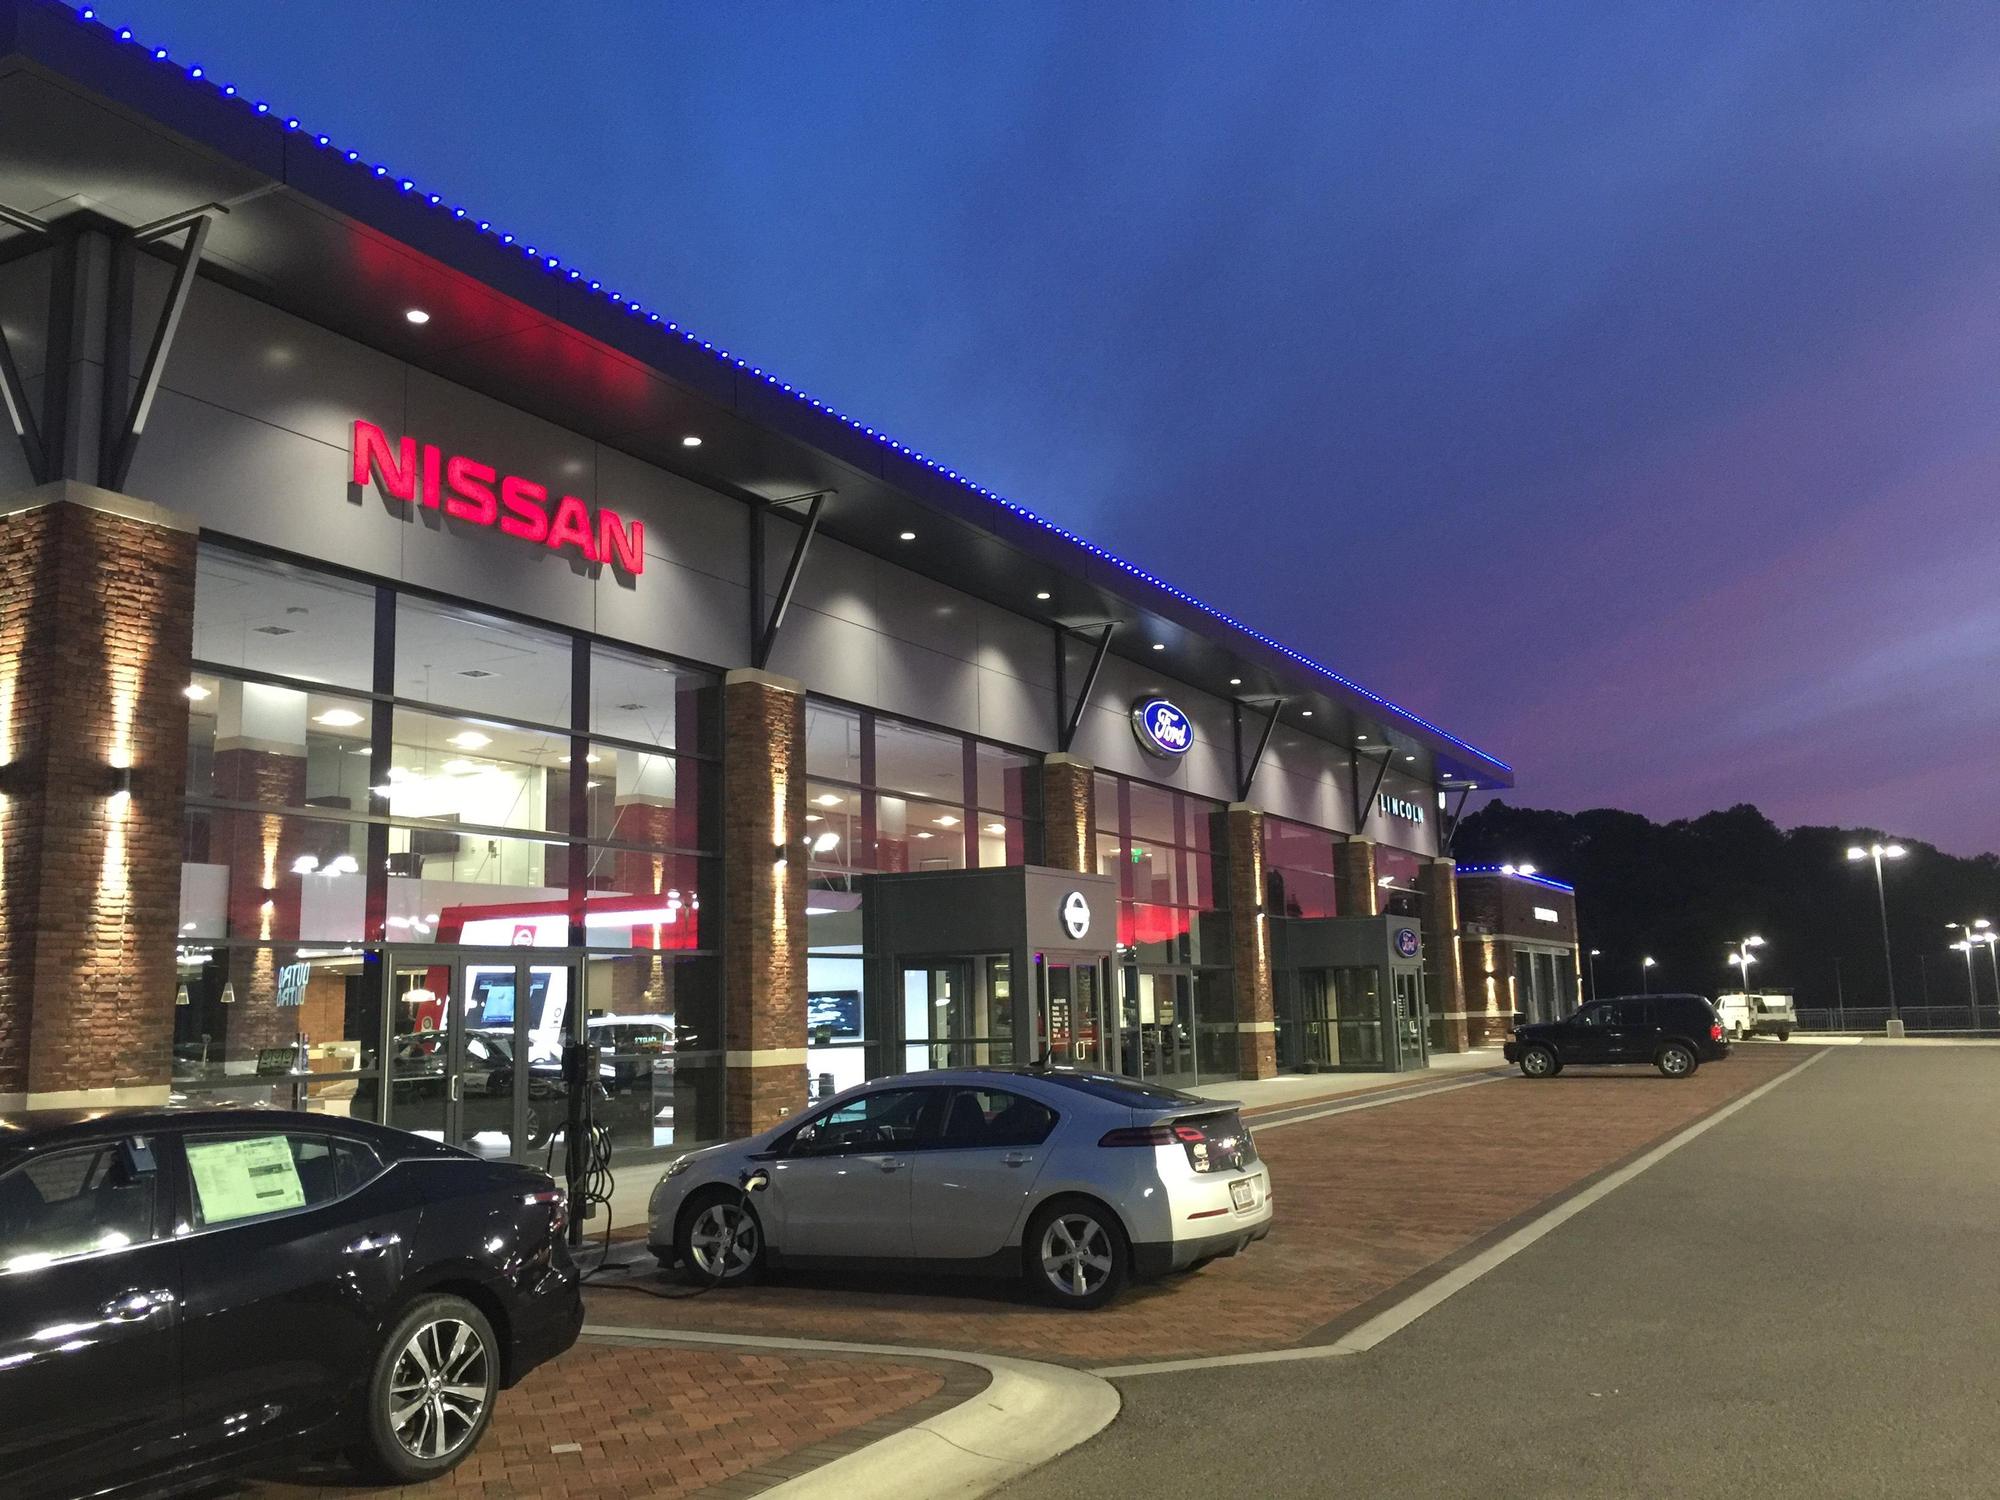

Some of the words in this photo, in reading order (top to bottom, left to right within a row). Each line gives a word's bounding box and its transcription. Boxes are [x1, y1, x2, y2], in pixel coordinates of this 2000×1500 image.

[353, 419, 645, 576] NISSAN
[1154, 707, 1187, 747] Ford
[1380, 793, 1424, 823] LINCOLN
